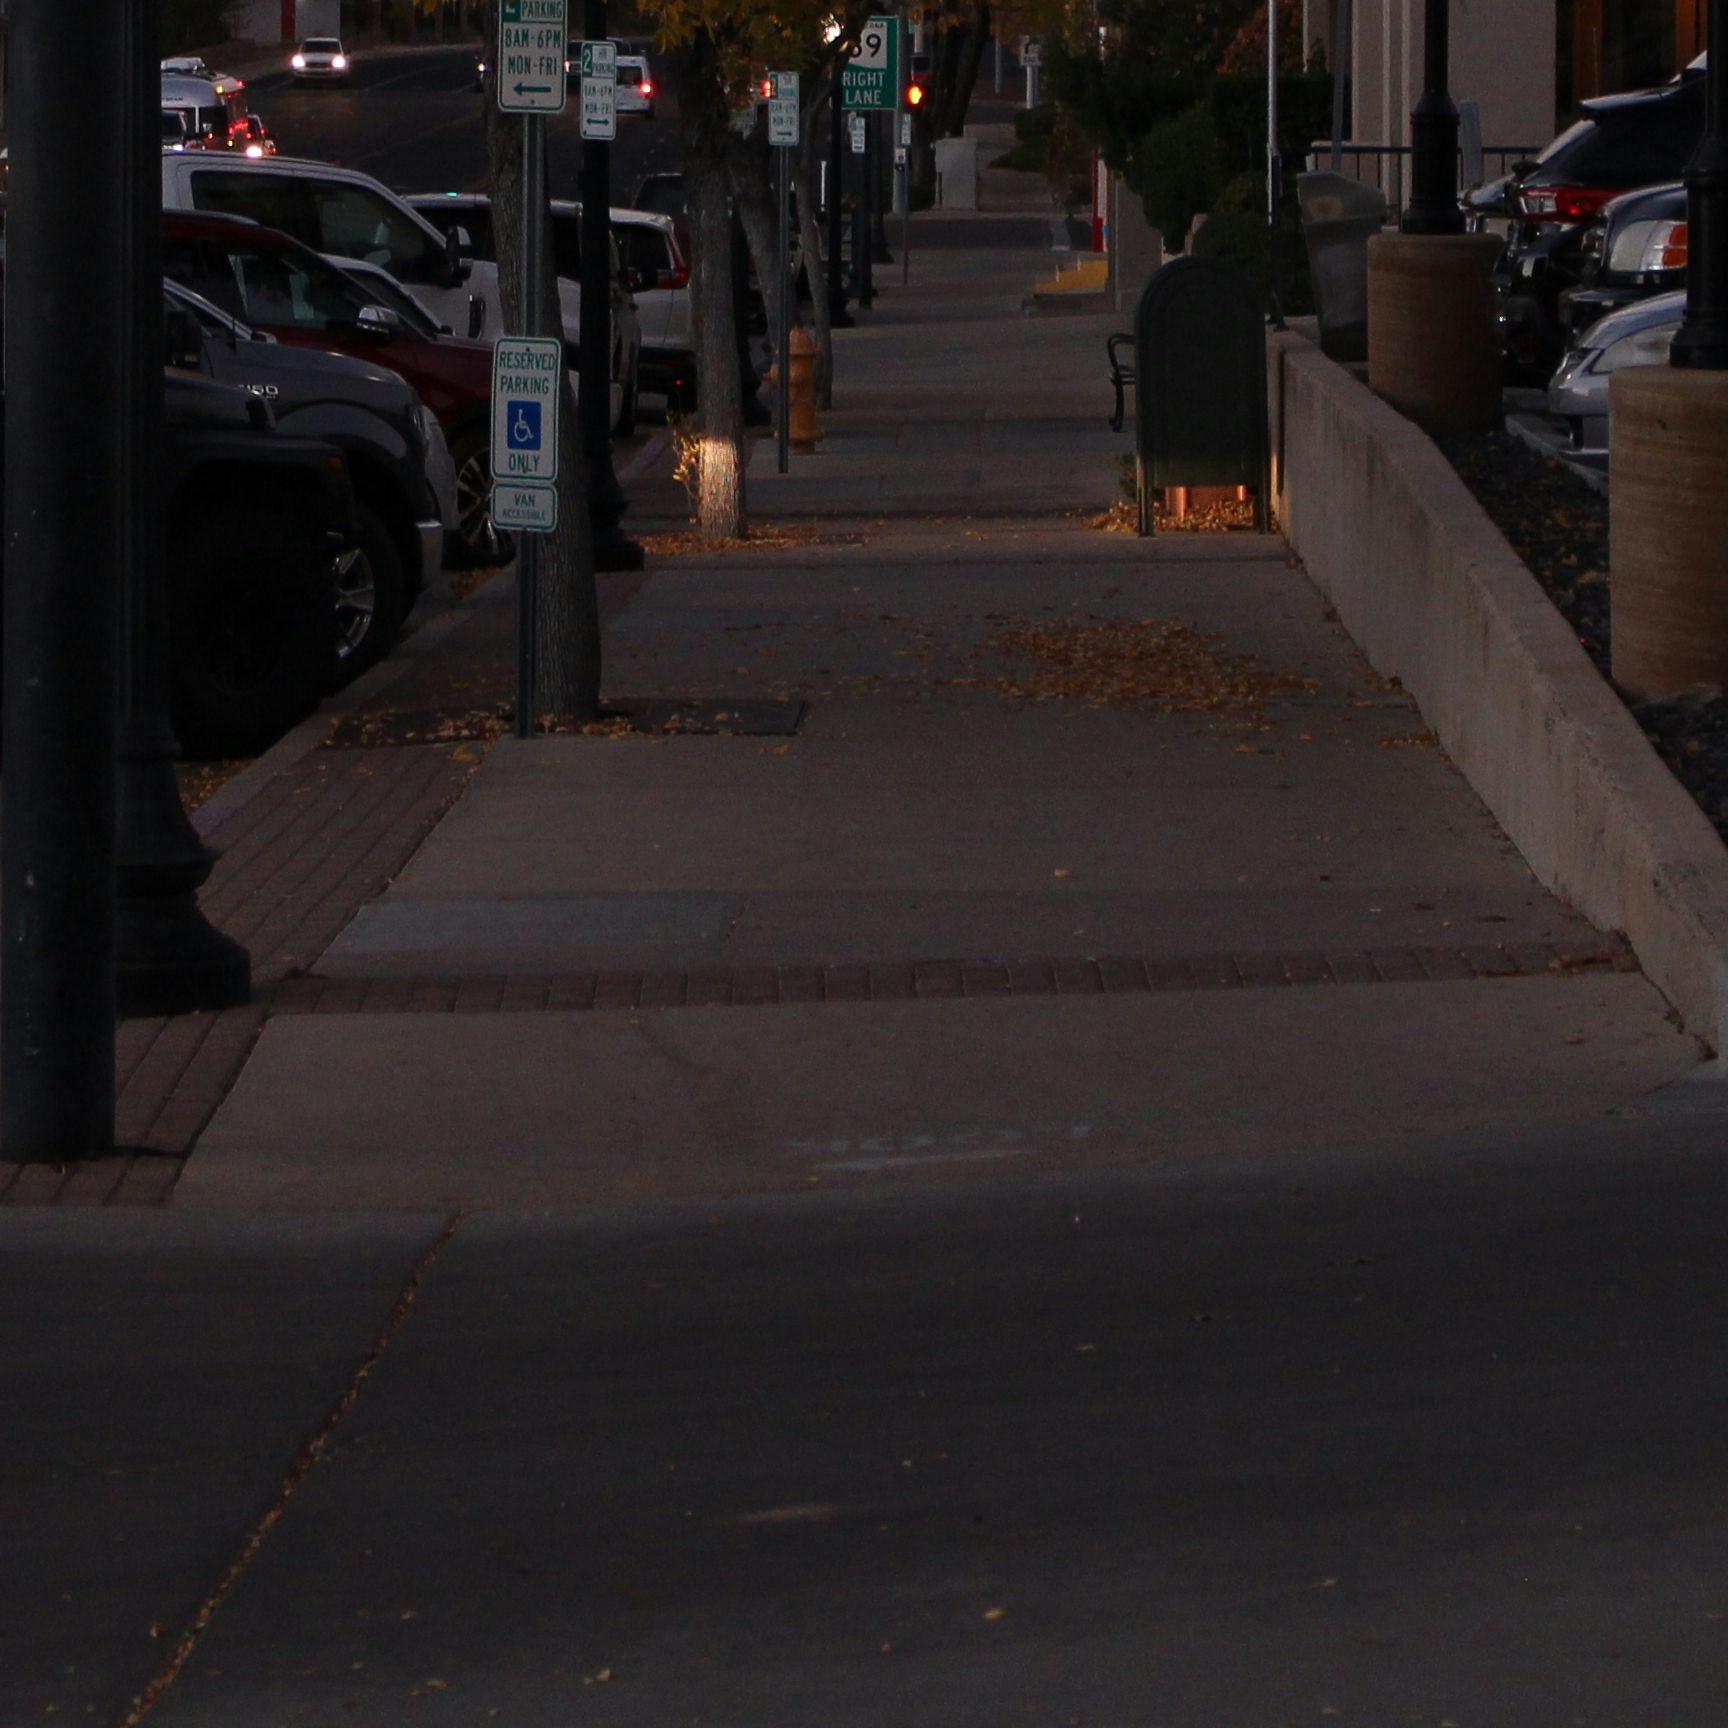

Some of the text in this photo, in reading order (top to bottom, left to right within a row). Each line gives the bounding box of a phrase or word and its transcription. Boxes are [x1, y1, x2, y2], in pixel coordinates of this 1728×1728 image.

[521, 1, 563, 19] PARKING
[505, 29, 561, 48] 8AM-6PM
[508, 56, 558, 75] MON-FRI
[583, 49, 592, 73] 2
[842, 71, 885, 87] RIGHT
[845, 89, 882, 105] LANE
[499, 351, 556, 371] RESERVED
[500, 376, 549, 395] PARKING
[508, 455, 540, 473] ONLY
[514, 494, 536, 507] VAN
